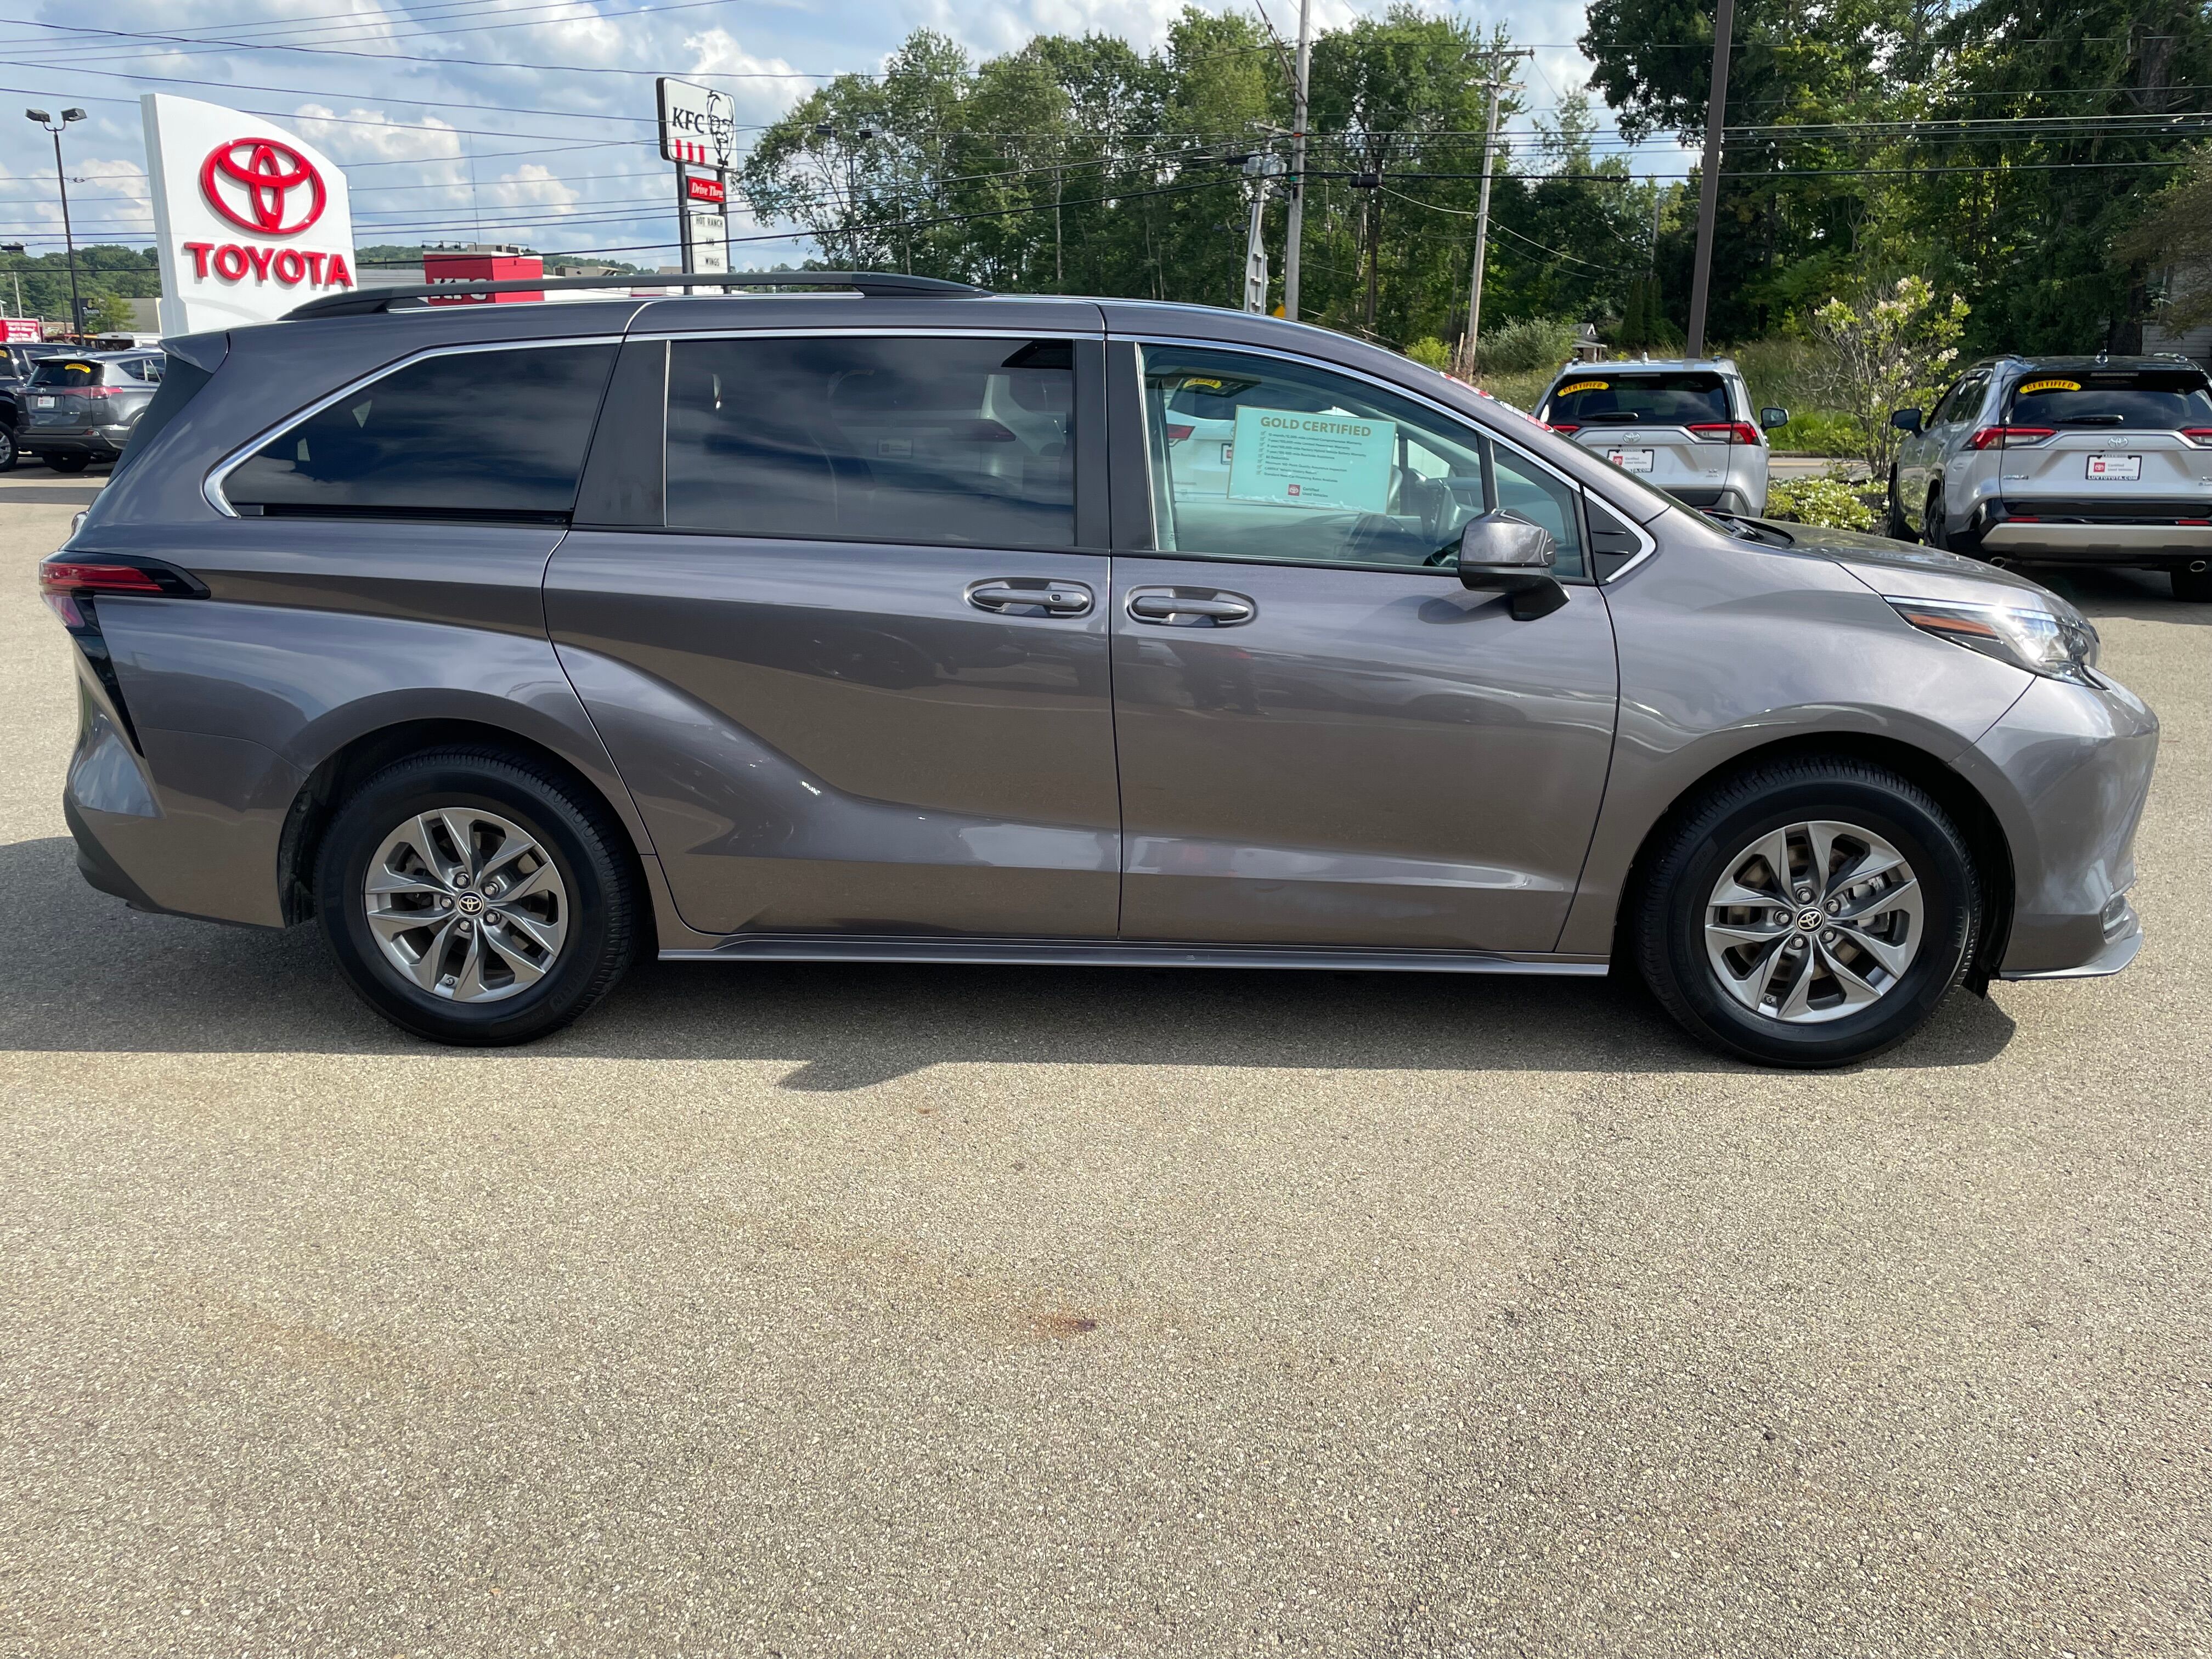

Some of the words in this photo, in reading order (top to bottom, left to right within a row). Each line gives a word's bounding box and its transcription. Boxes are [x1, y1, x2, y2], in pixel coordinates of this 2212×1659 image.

[673, 106, 704, 134] KFC
[692, 182, 708, 196] Drive
[184, 241, 354, 287] TOYOTA
[1260, 416, 1300, 430] GOLD
[1302, 421, 1372, 437] CERTIFIED
